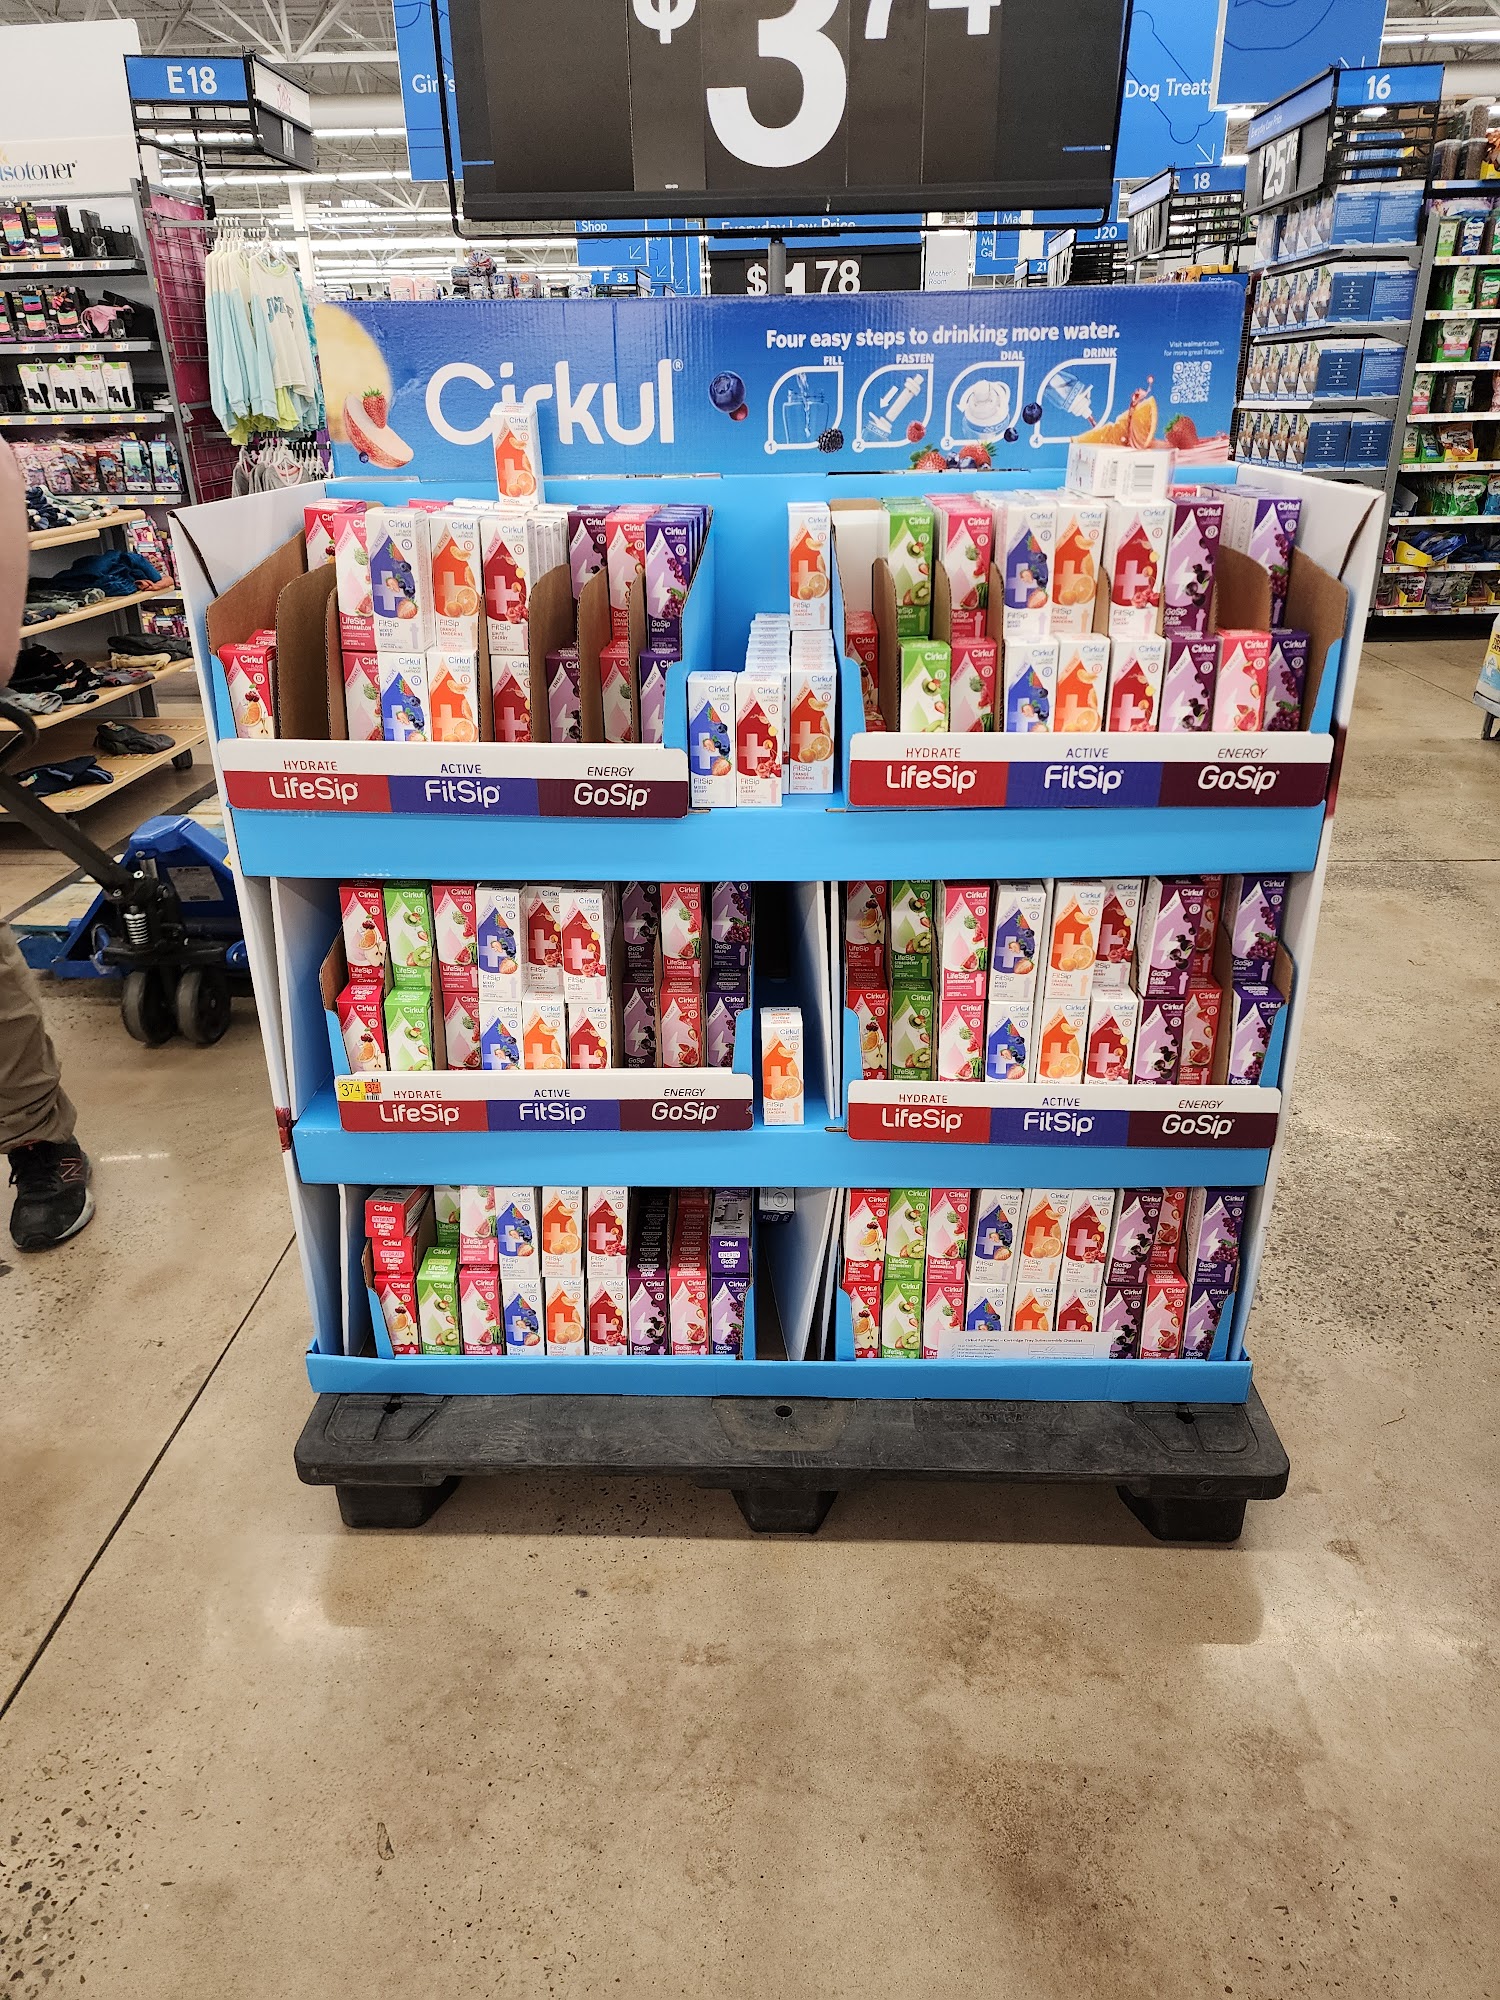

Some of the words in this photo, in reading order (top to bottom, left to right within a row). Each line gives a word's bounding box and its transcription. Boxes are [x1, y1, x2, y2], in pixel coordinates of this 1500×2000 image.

[166, 65, 218, 95] E18
[412, 73, 456, 94] Gir's
[1125, 79, 1160, 101] Dog
[1165, 78, 1213, 97] Treats
[1366, 74, 1392, 100] 16
[1193, 172, 1211, 190] 18
[581, 220, 608, 232] Shop
[1094, 226, 1118, 240] J20
[928, 268, 957, 277] Mother's
[616, 273, 629, 283] 35
[928, 278, 947, 286] Room
[766, 329, 807, 349] Four
[810, 331, 852, 351] easy
[855, 328, 905, 350] steps
[909, 327, 929, 345] to
[932, 324, 1008, 346] drinking
[1012, 326, 1060, 342] more
[1063, 321, 1120, 340] water.
[1000, 350, 1025, 361] DIAL
[1083, 347, 1118, 359] DRINK
[823, 355, 845, 366] FILL
[895, 353, 935, 364] FASTEN
[388, 519, 412, 528] Cirkul
[451, 521, 474, 530] Cirkul
[501, 525, 524, 534] Cirkul
[665, 526, 687, 536] Cirkul
[341, 617, 366, 626] LifeSip
[378, 620, 400, 629] FitSip
[439, 619, 460, 628] FitSip
[651, 620, 671, 629] GoSip
[491, 623, 511, 632] FitSip
[240, 655, 264, 665] Cirkul
[398, 657, 421, 665] Cirkul
[448, 656, 471, 664] Cirkul
[906, 747, 961, 759] HYDRATE
[1066, 747, 1109, 759] ACTIVE
[1217, 748, 1268, 759] ENERGY
[283, 760, 338, 771] HYDRATE
[441, 763, 482, 774] ACTIVE
[587, 766, 635, 777] ENERGY
[740, 777, 760, 786] FitSip
[886, 764, 977, 795] LifeSip
[1044, 764, 1124, 795] FitSip
[1197, 764, 1280, 795] GoSip
[268, 776, 359, 805] LifeSip
[425, 779, 500, 808] FitSip
[573, 782, 651, 811] GoSip
[358, 890, 379, 899] Cirkul
[450, 888, 472, 897] Cirkul
[678, 886, 699, 894] Cirkul
[1181, 888, 1204, 897] Cirkul
[402, 891, 424, 900] Cirkul
[495, 895, 516, 903] Cirkul
[965, 891, 987, 899] Cirkul
[714, 943, 732, 951] GoSip
[666, 959, 688, 967] LifeSip
[894, 954, 916, 963] LifeSip
[351, 966, 373, 975] LifeSip
[395, 966, 418, 975] LifeSip
[442, 965, 465, 973] LifeSip
[1150, 969, 1172, 978] GoSip
[946, 972, 970, 981] LifeSip
[678, 996, 698, 1004] Cirkul
[724, 996, 745, 1004] Cirkul
[865, 992, 886, 1000] Cirkul
[1198, 992, 1220, 1000] Cirkul
[356, 1004, 377, 1013] Cirkul
[403, 1006, 424, 1014] Cirkul
[960, 1004, 982, 1012] Cirkul
[1162, 1003, 1184, 1011] Cirkul
[393, 1090, 442, 1099] HYDRATE
[533, 1089, 571, 1098] ACTIVE
[663, 1088, 706, 1097] ENERGY
[899, 1094, 948, 1104] HYDRATE
[1042, 1097, 1081, 1107] ACTIVE
[766, 1100, 785, 1109] FitSip
[1178, 1099, 1224, 1110] ENERGY
[379, 1103, 460, 1125] LifeSip
[519, 1102, 587, 1124] FitSip
[651, 1101, 720, 1124] GoSip
[881, 1107, 964, 1133] LifeSip
[1023, 1111, 1095, 1137] FitSip
[1161, 1113, 1235, 1140] GoSip
[907, 1189, 927, 1197] Cirkul
[949, 1191, 969, 1199] Cirkul
[868, 1196, 887, 1204] Cirkul
[374, 1204, 394, 1212] Cirkul
[373, 1223, 394, 1231] LifeSip
[382, 1239, 402, 1247] Cirkul
[382, 1257, 403, 1265] LifeSip
[720, 1258, 739, 1266] GoSip
[848, 1261, 870, 1269] LifeSip
[645, 1280, 665, 1288] Cirkul
[687, 1279, 706, 1287] Cirkul
